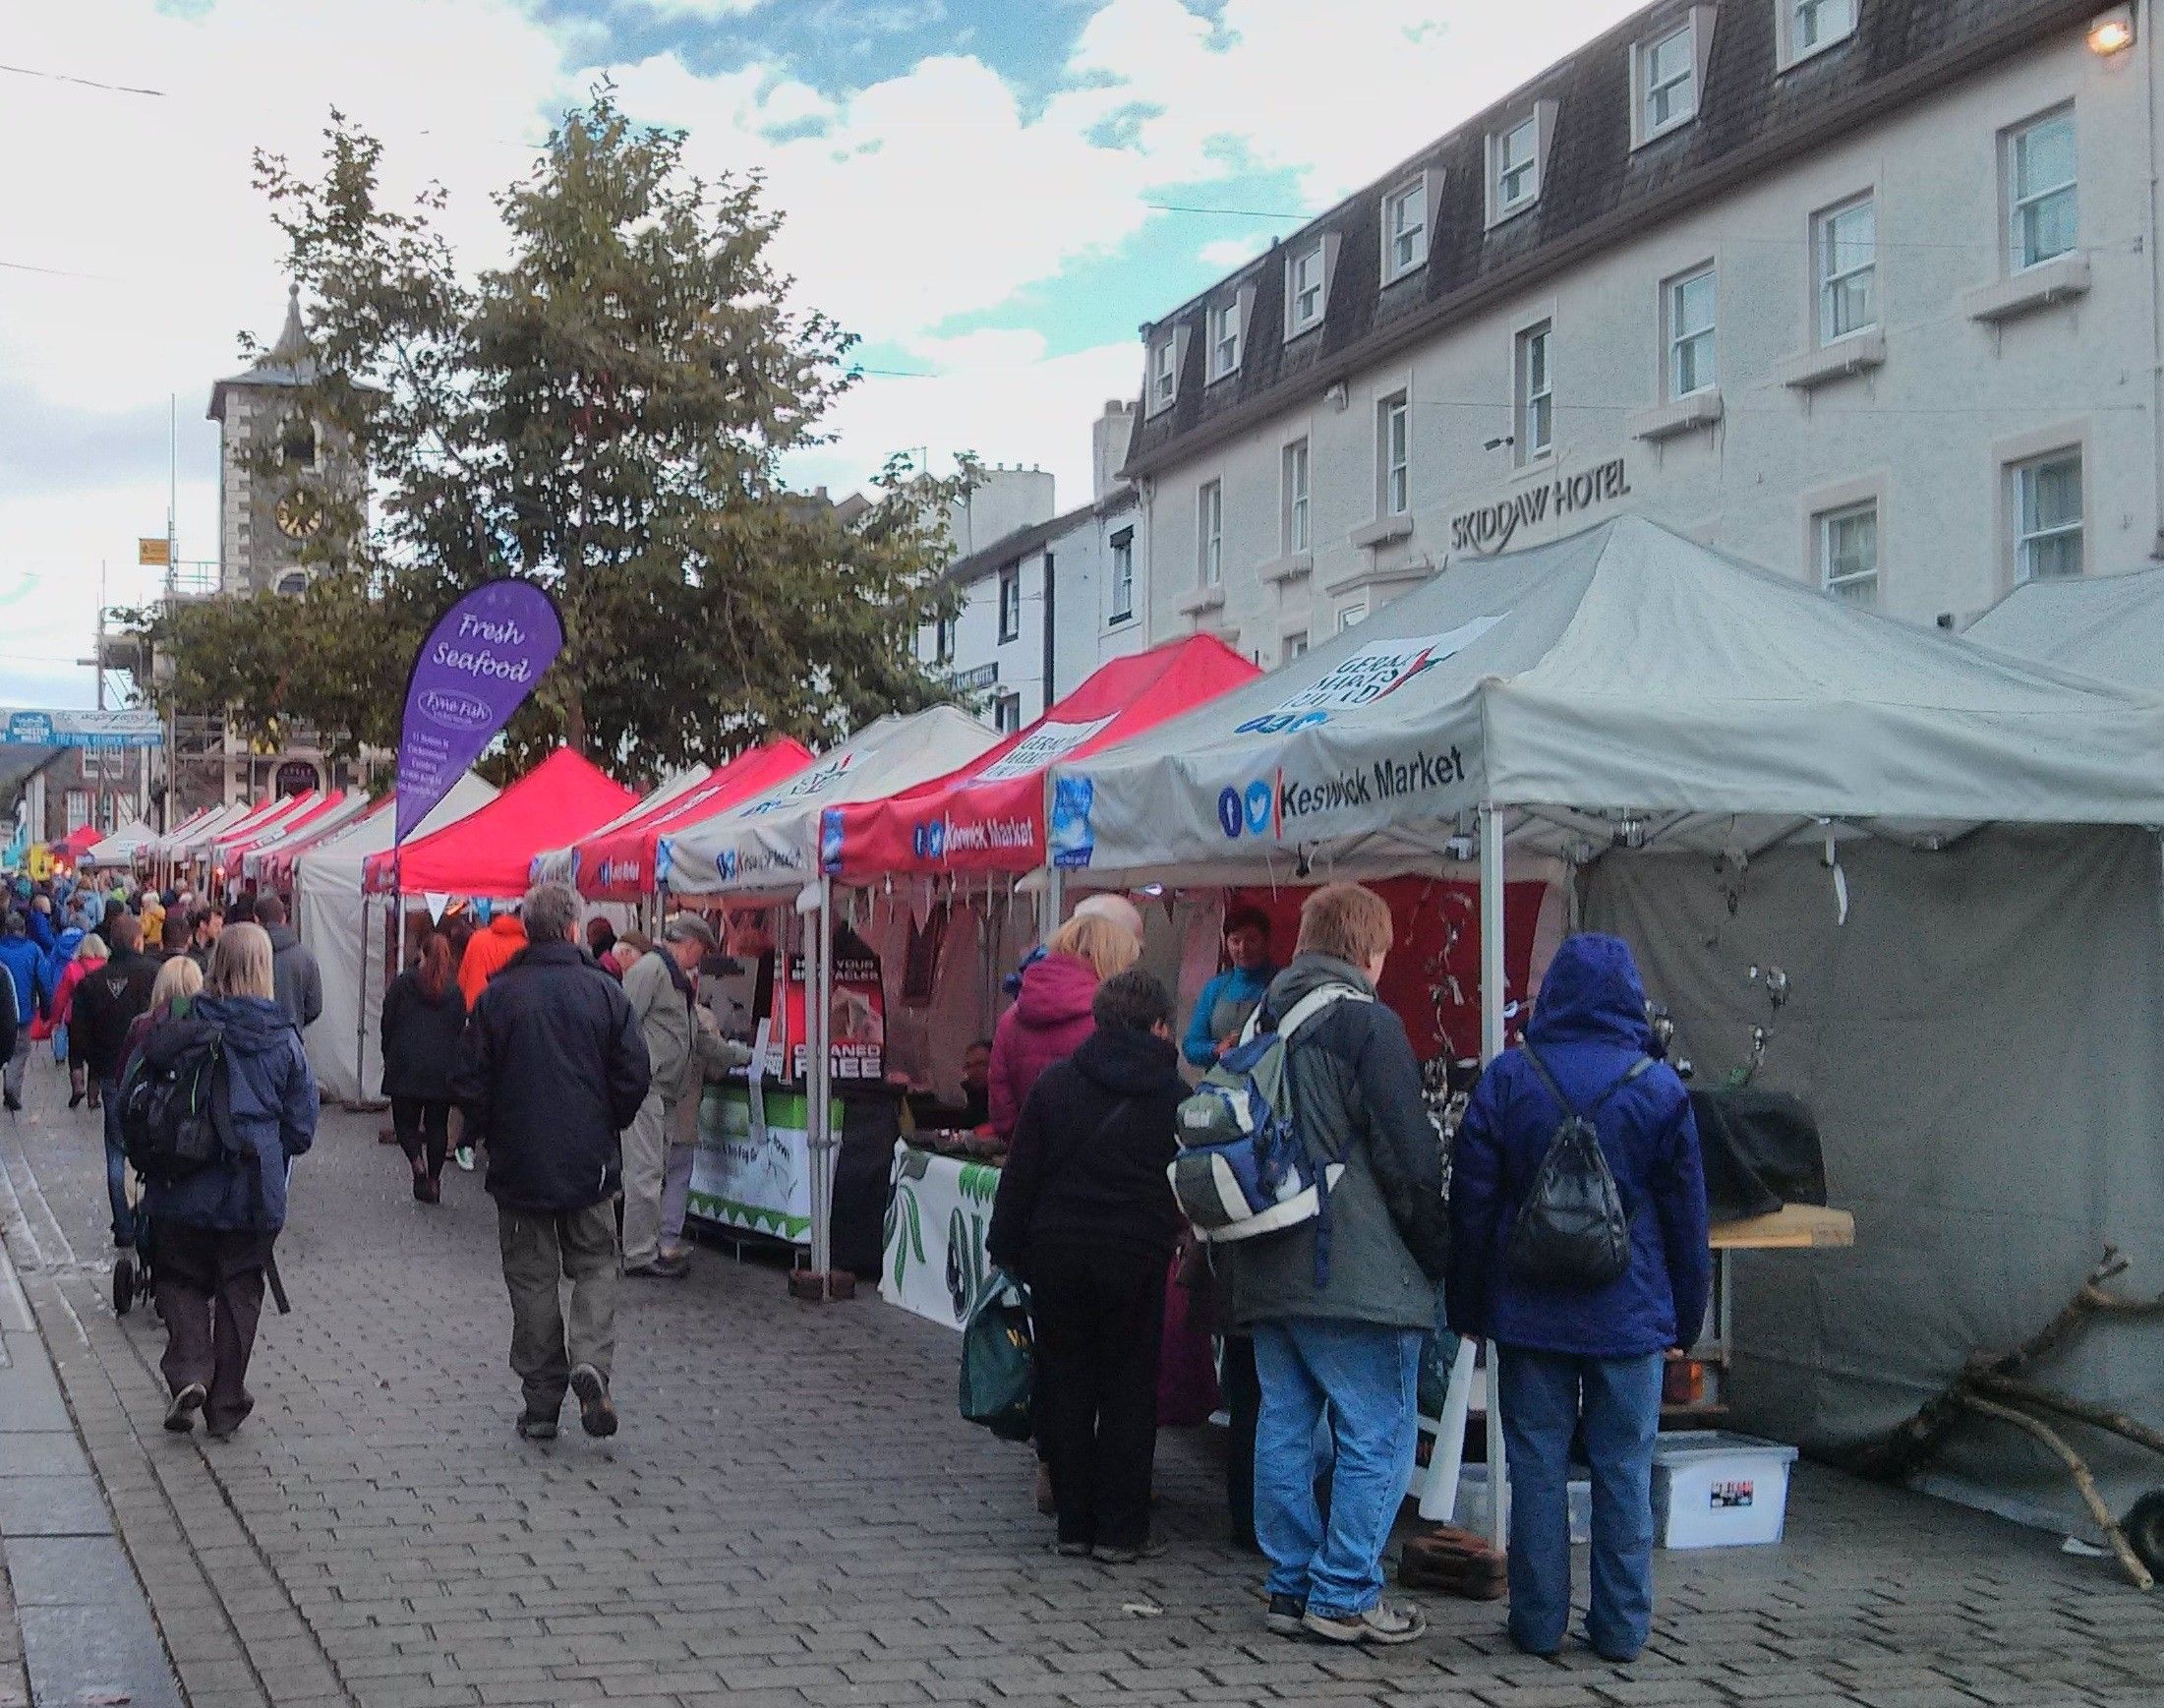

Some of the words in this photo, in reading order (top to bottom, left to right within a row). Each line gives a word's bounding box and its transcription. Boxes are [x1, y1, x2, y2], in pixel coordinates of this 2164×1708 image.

[1450, 485, 1550, 555] SKIDDAW
[1553, 457, 1632, 517] HOTEL
[458, 613, 526, 645] Fresh
[433, 642, 532, 683] Seafood
[1279, 770, 1372, 820] Keswick
[1374, 744, 1466, 800] Market
[794, 1042, 882, 1058] CANED
